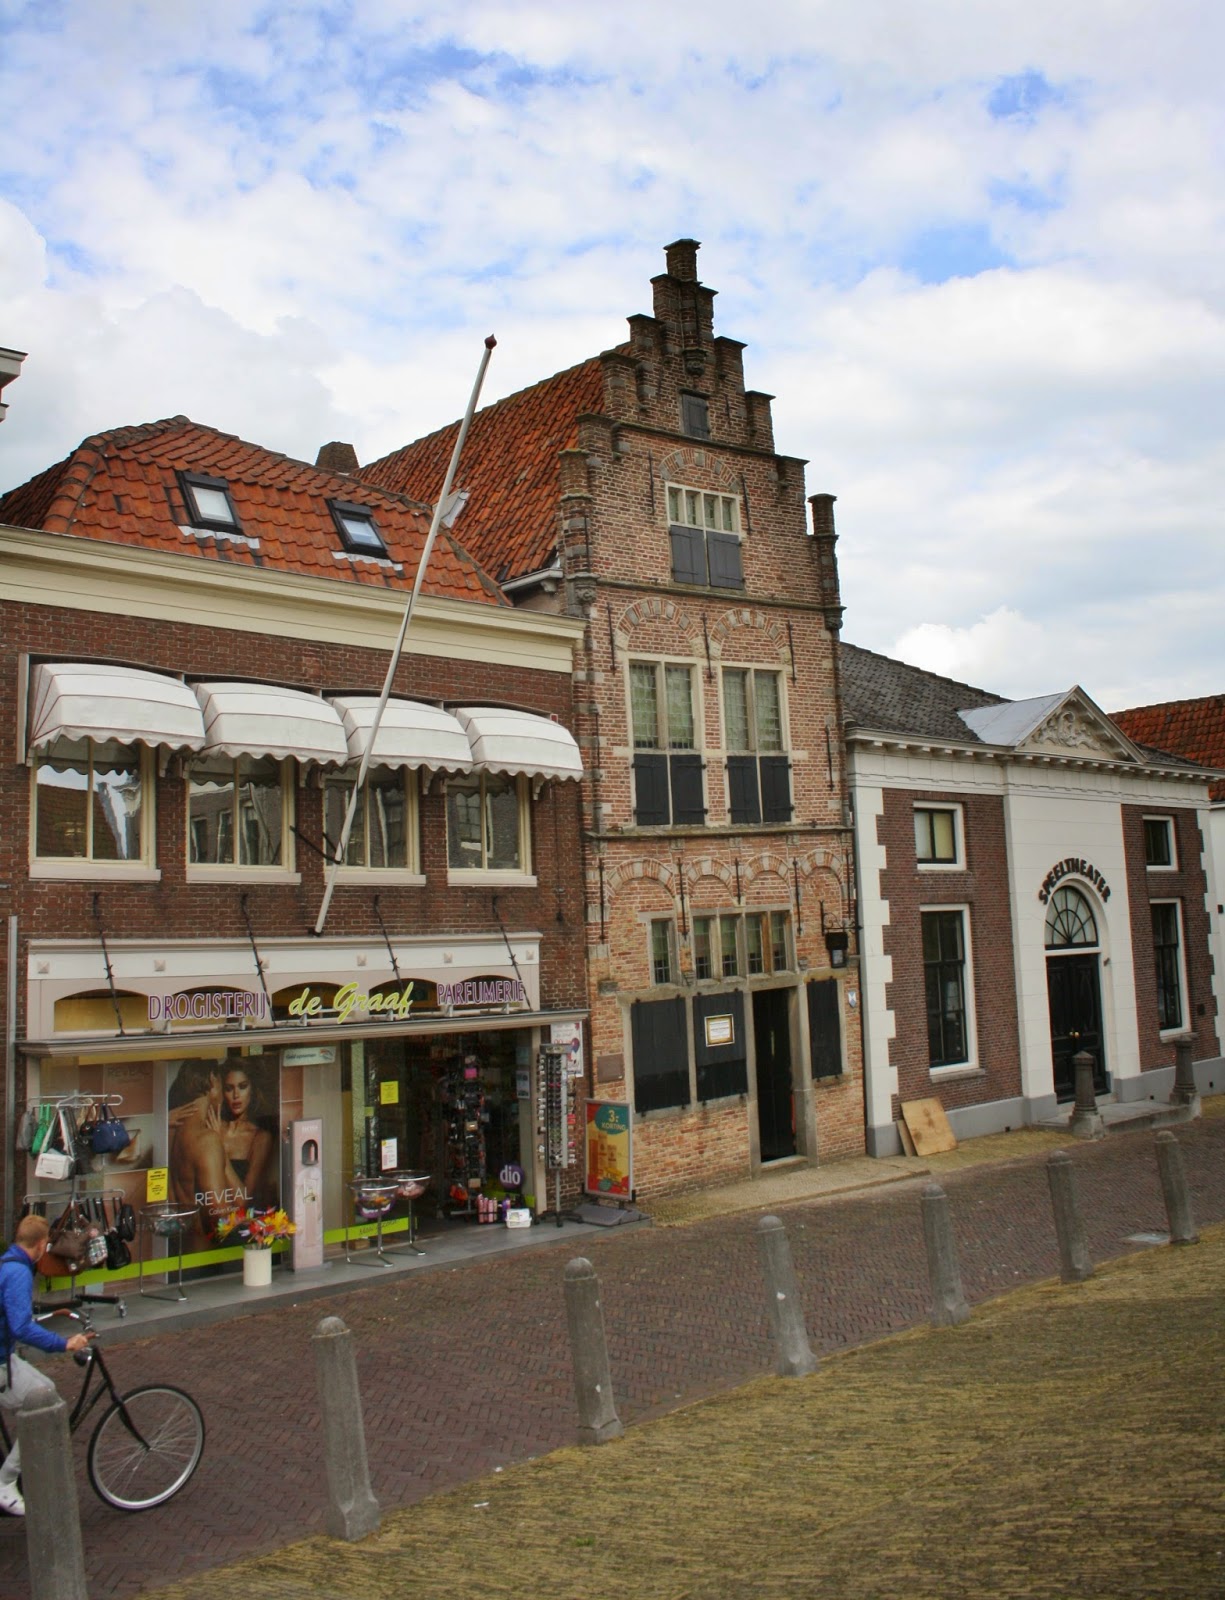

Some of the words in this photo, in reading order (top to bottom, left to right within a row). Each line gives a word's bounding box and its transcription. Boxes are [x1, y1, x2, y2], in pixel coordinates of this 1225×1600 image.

[1038, 857, 1111, 905] SPEELTHEATER
[147, 991, 267, 1021] DROGISTERIJ
[288, 987, 323, 1016] de
[333, 982, 414, 1024] Graaf
[437, 980, 525, 1006] PARFUMERIE
[500, 1164, 521, 1185] dio
[195, 1186, 253, 1206] REVEAL
